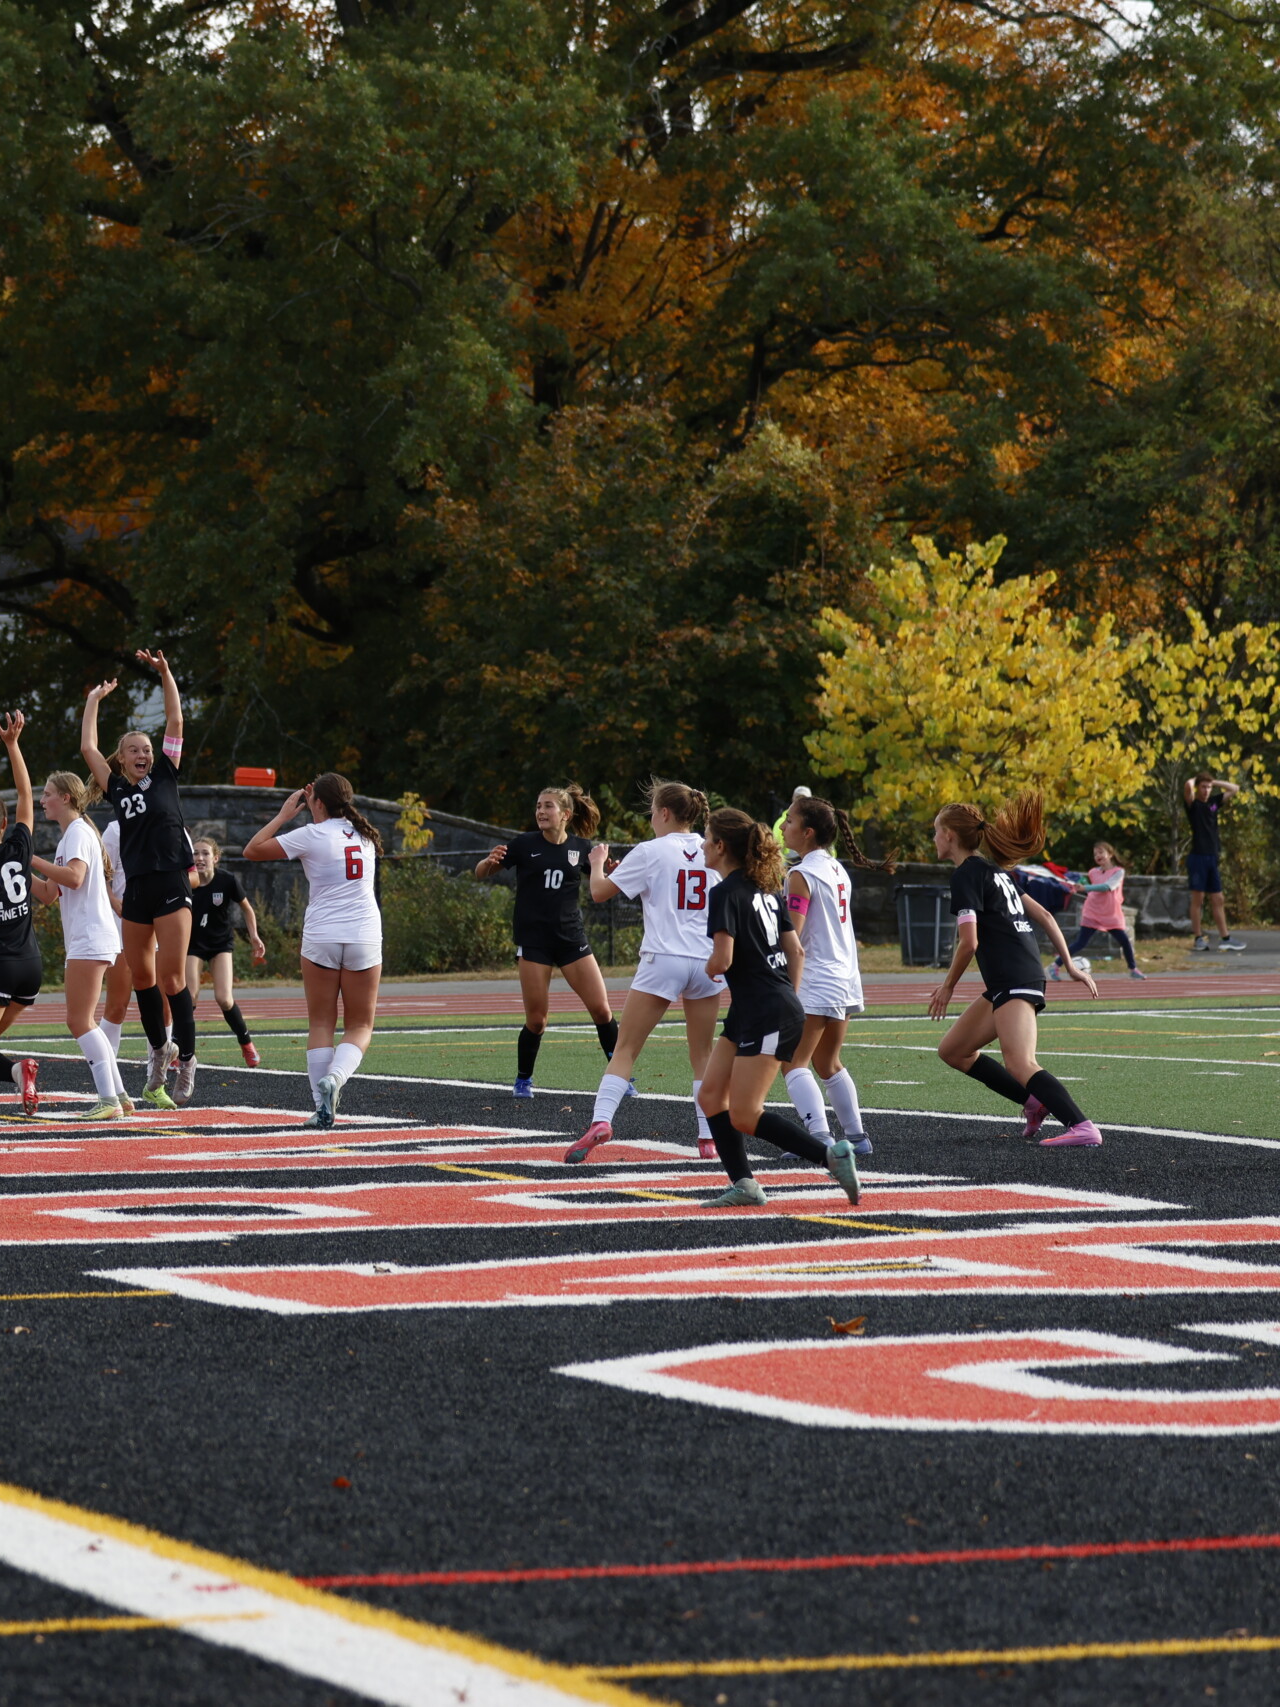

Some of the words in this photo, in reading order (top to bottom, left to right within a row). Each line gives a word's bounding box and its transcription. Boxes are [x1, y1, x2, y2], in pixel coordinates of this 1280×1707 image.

[121, 793, 147, 820] 23
[345, 845, 363, 881] 6
[544, 868, 564, 889] 10
[676, 868, 707, 911] 13
[789, 896, 801, 910] C
[837, 883, 847, 923] 5
[993, 872, 1024, 915] 15
[200, 913, 208, 928] 4
